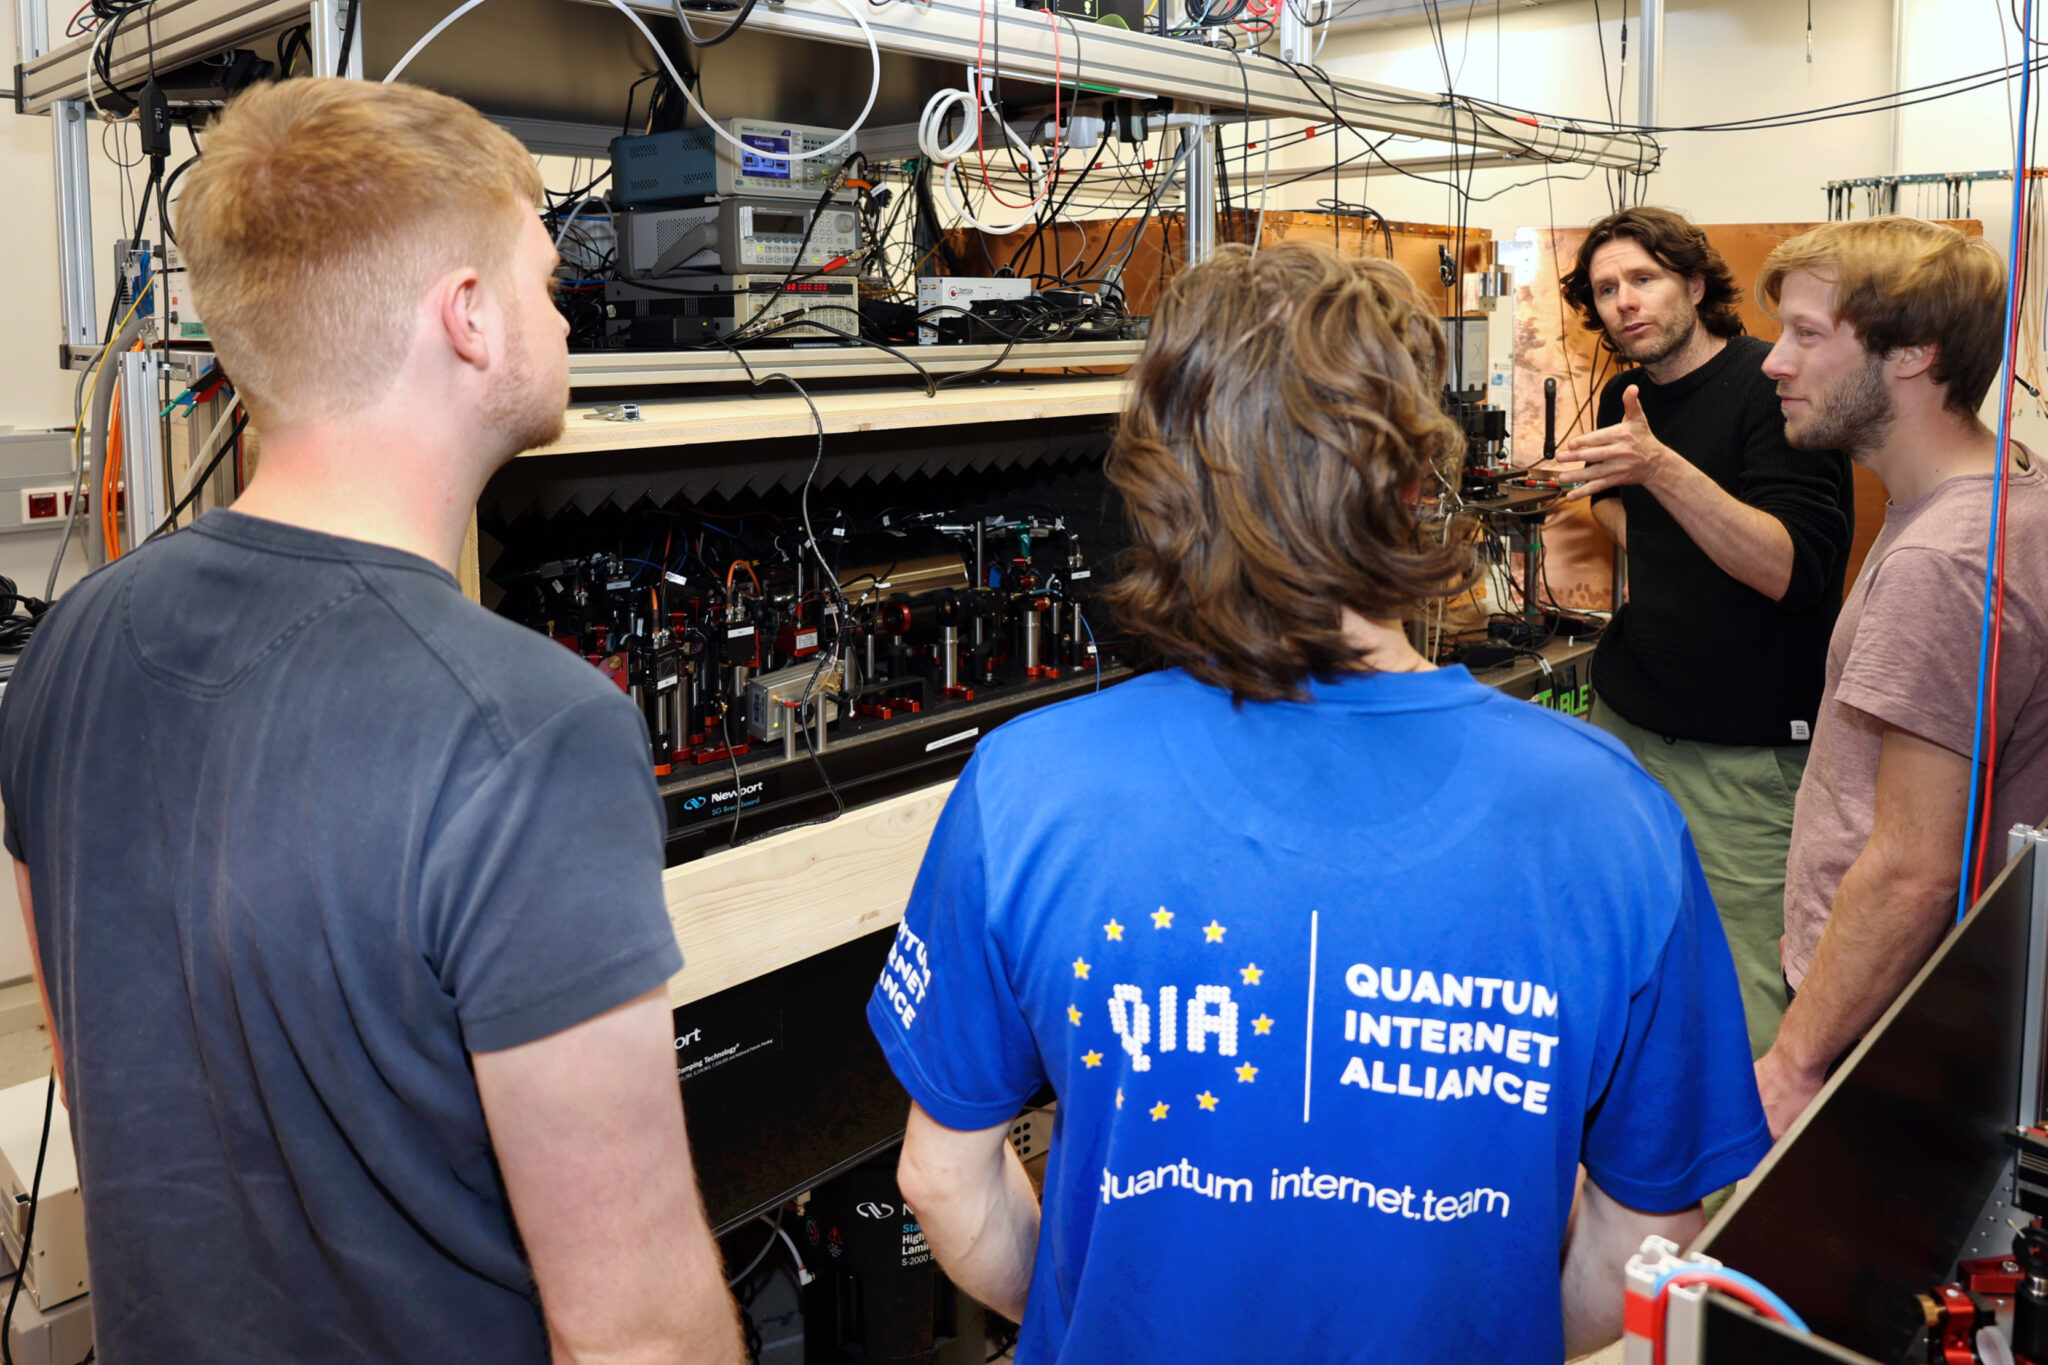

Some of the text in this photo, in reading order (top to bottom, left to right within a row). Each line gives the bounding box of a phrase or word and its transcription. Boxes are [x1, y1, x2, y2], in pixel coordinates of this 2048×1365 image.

[1538, 684, 1589, 715] TBLE
[724, 796, 760, 812] Breaboard
[1345, 963, 1558, 1019] QUANTUM
[1107, 983, 1239, 1072] QIA
[1344, 1009, 1559, 1068] INTERNET
[1339, 1056, 1551, 1115] ALLIANCE
[1271, 1166, 1510, 1222] internet.team
[902, 1223, 920, 1234] Sta
[902, 1242, 929, 1256] Lami
